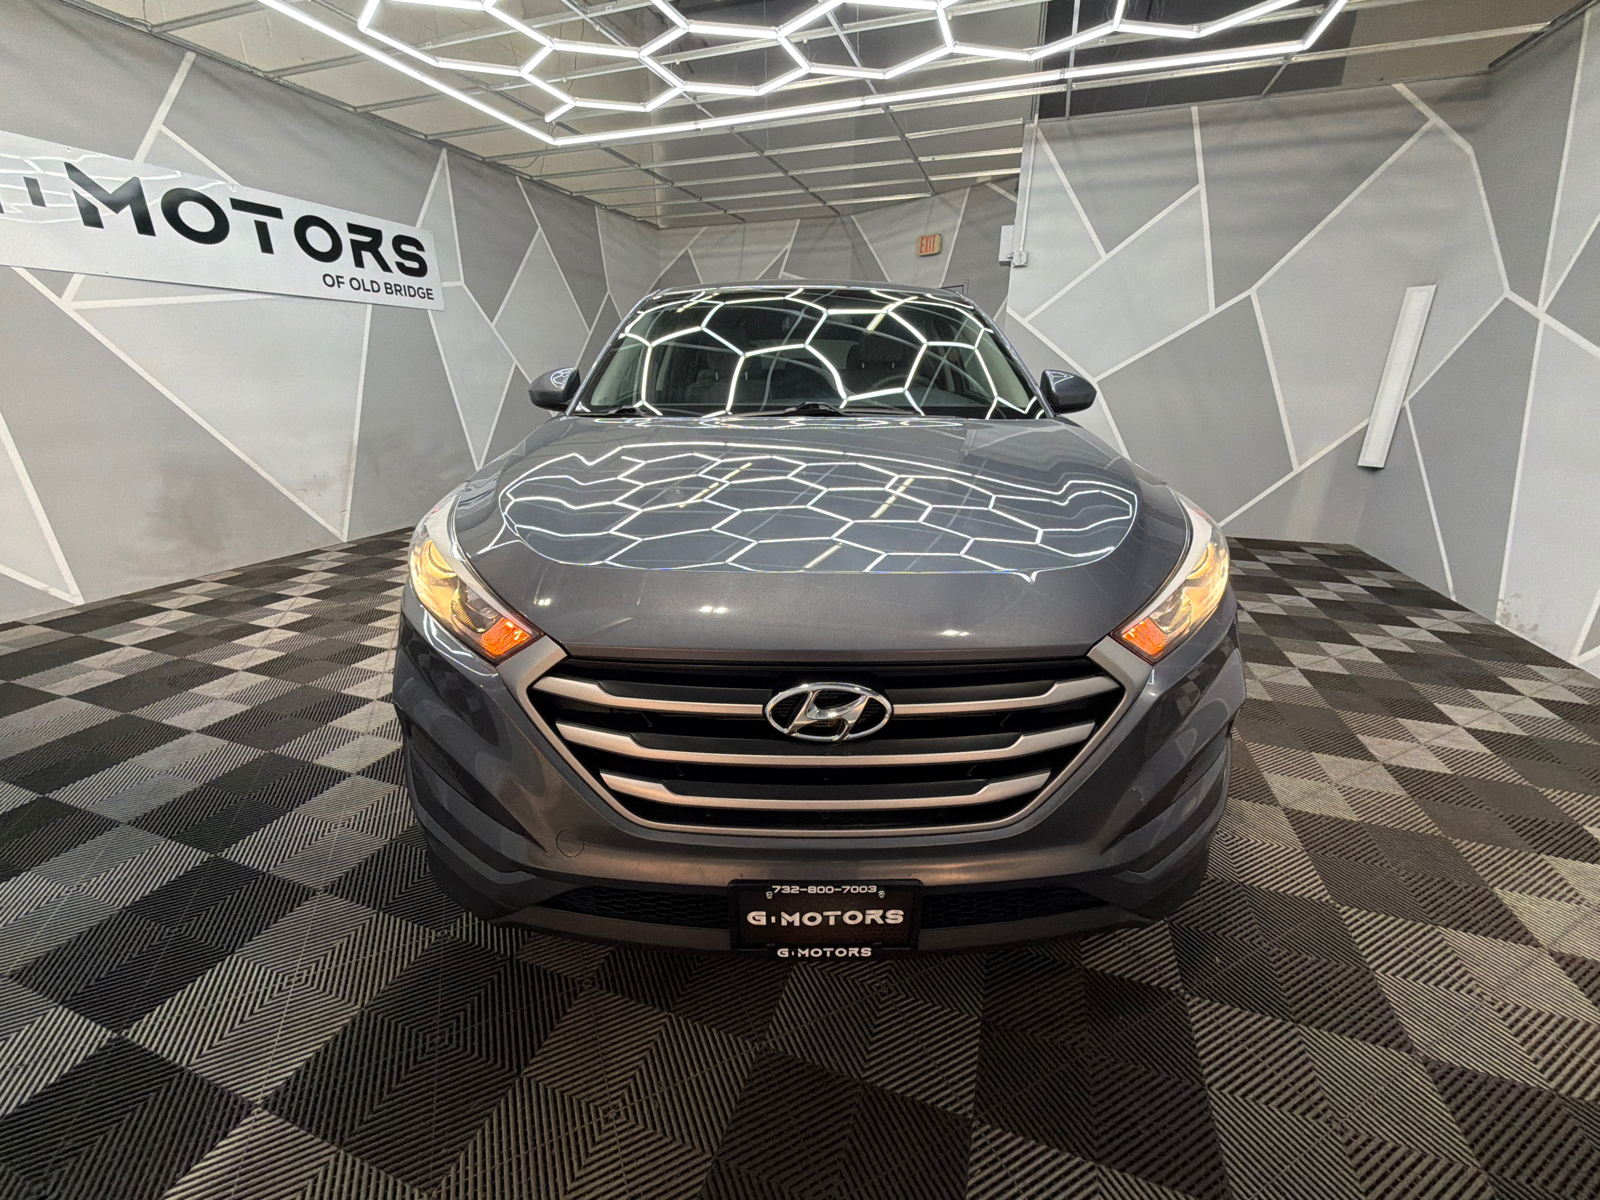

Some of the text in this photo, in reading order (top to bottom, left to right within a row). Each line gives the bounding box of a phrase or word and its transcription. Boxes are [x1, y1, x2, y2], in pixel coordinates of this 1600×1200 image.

[919, 234, 937, 254] EXIT
[322, 273, 435, 300] OF OLD BRIDGE
[771, 885, 878, 894] 732-800-7003
